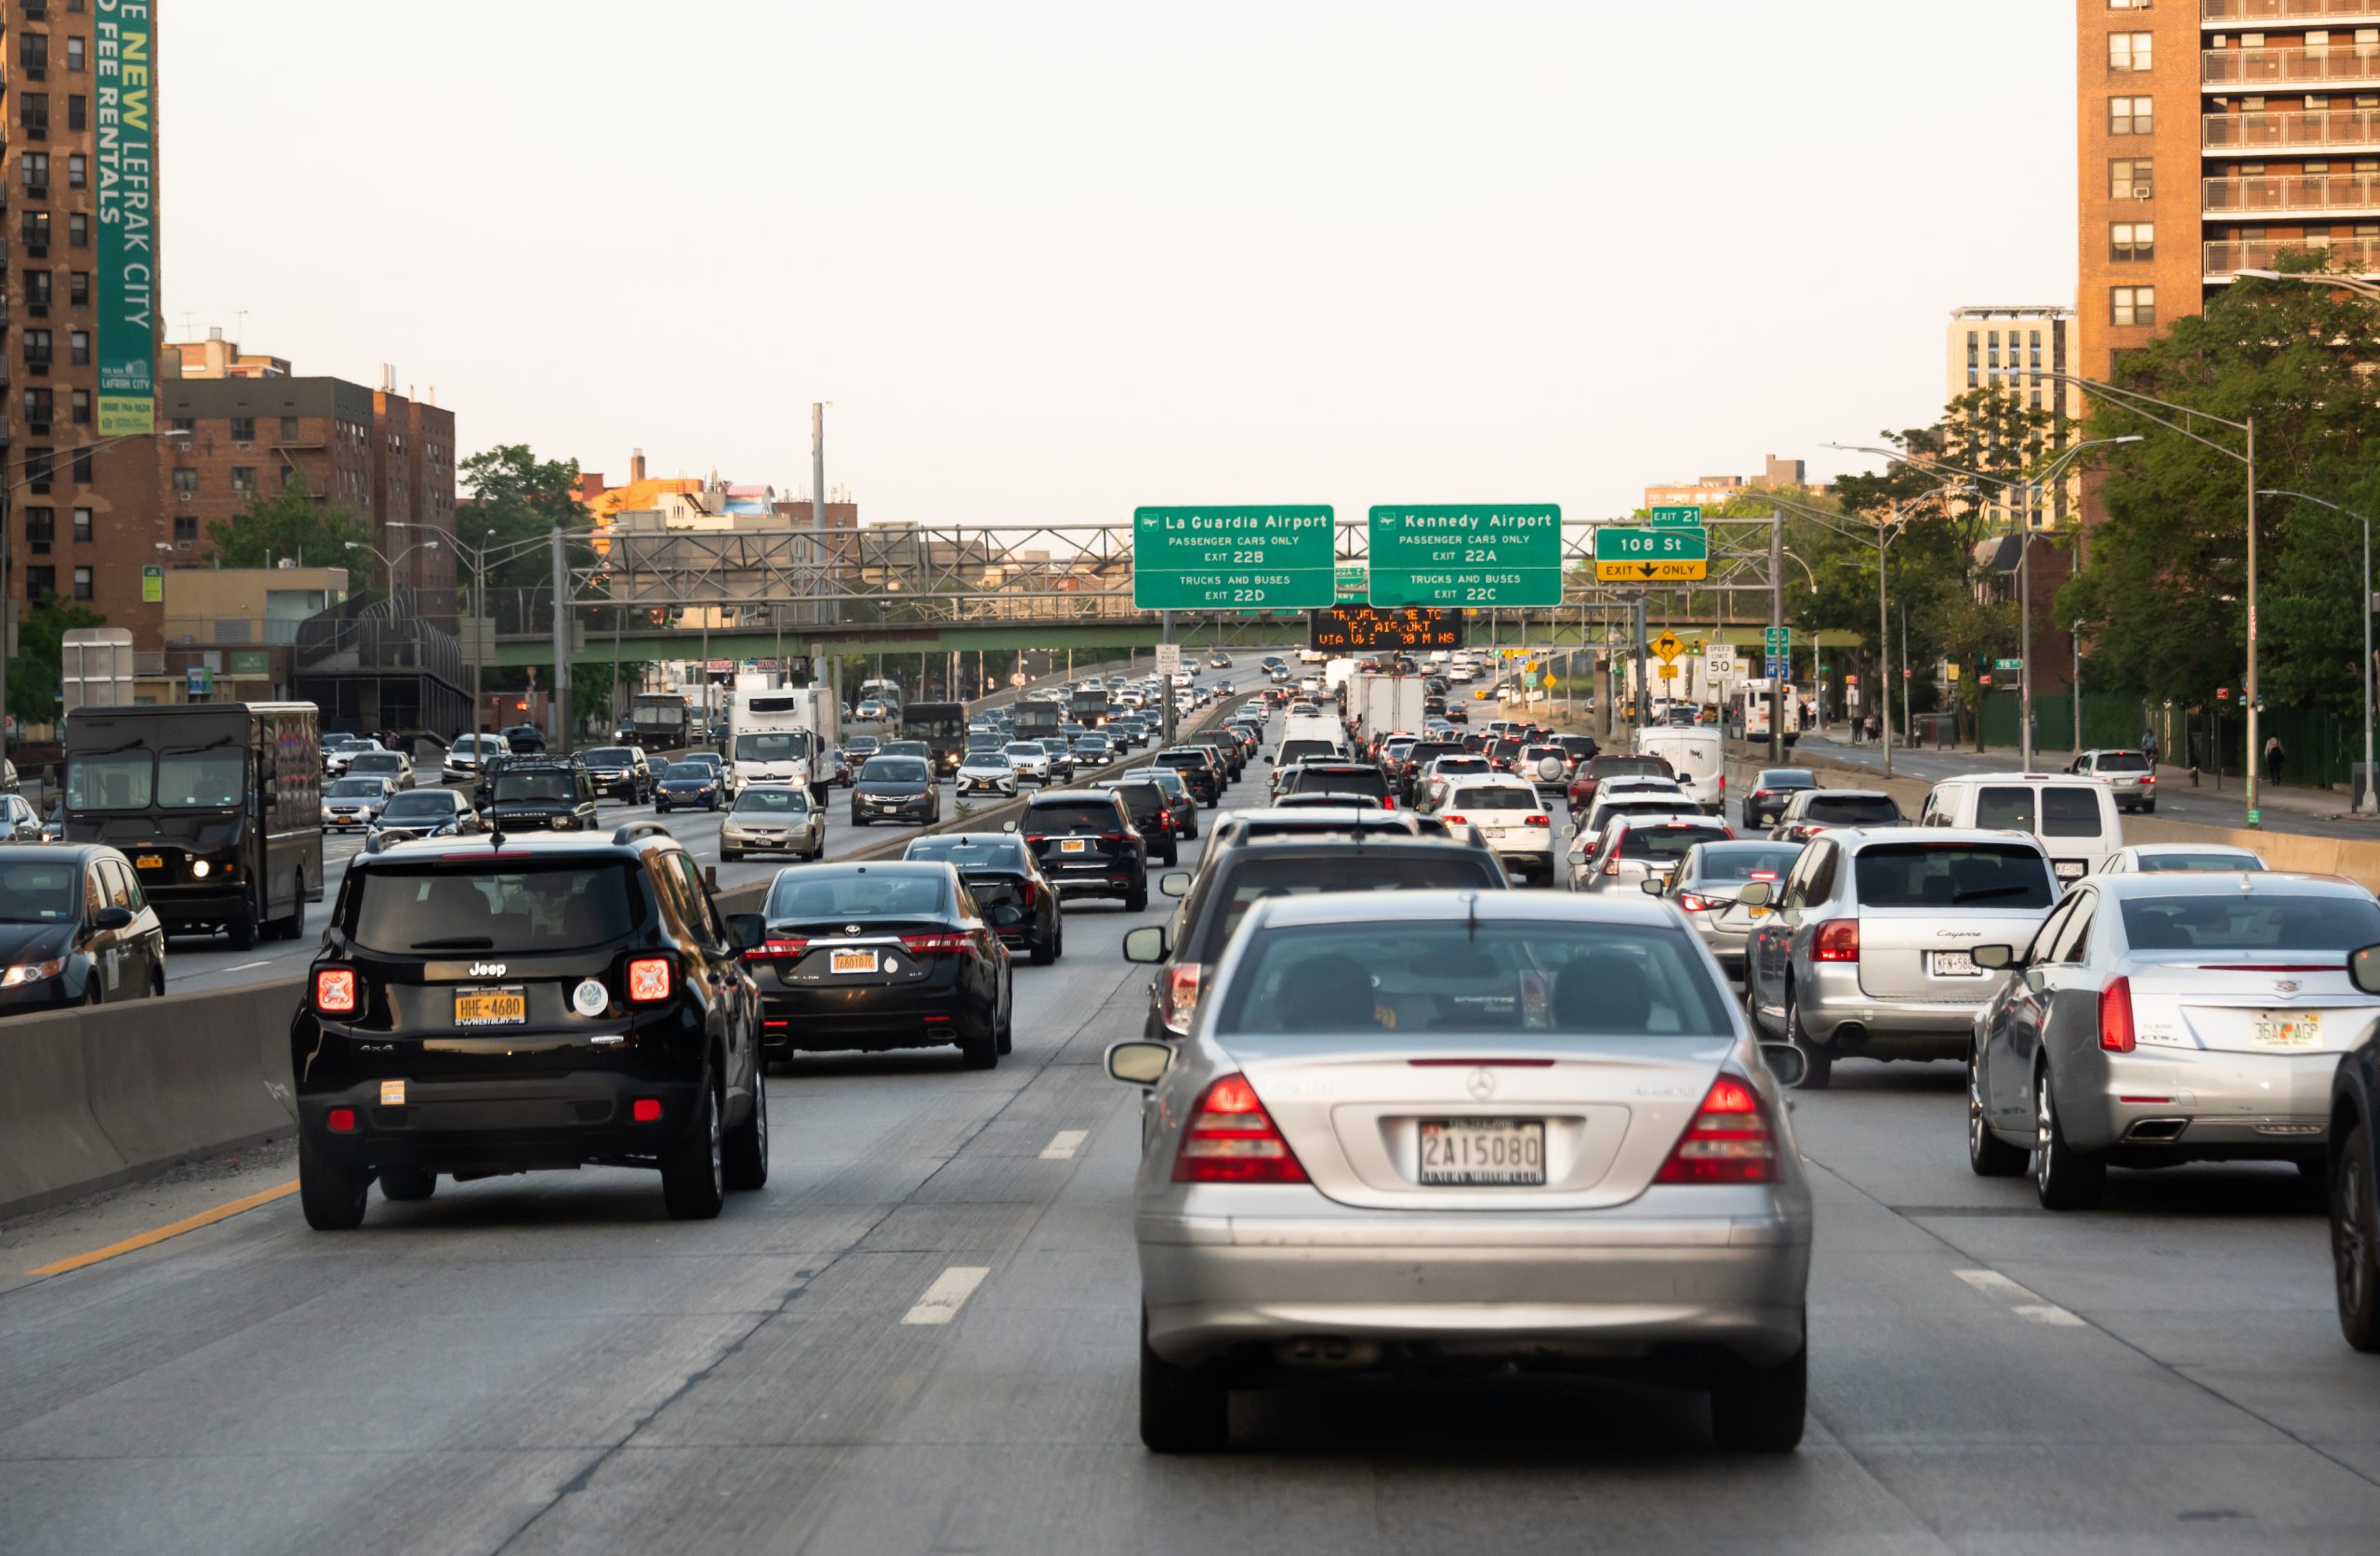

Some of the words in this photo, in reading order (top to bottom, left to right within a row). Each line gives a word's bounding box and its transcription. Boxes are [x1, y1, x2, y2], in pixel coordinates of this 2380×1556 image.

[98, 21, 118, 76] FEE
[122, 32, 148, 131] NEW
[99, 86, 120, 224] RENTALS
[123, 142, 149, 252] LEFRAK
[124, 263, 150, 329] CITY
[1405, 514, 1479, 530] Kennedy
[1489, 513, 1553, 529] Airport
[1654, 512, 1675, 521] EXIT
[1683, 510, 1699, 522] 21
[1165, 516, 1185, 529] La
[1191, 515, 1259, 529] Guardia
[1265, 514, 1328, 531] Airport
[1169, 537, 1232, 546] PASSENGER
[1236, 536, 1265, 546] CARS
[1271, 536, 1300, 545] ONLY
[1399, 535, 1462, 545] PASSENGER
[1467, 535, 1497, 544] CARS
[1501, 534, 1530, 544] ONLY
[1620, 538, 1654, 551] 108
[1663, 538, 1682, 550] St
[1204, 553, 1228, 561] EXIT
[1233, 551, 1264, 563] 22B
[1432, 551, 1456, 560] EXIT
[1464, 549, 1497, 562] 22A
[1606, 566, 1633, 575] EXIT
[1662, 565, 1696, 574] ONLY
[1179, 576, 1222, 585] TRUCKS
[1227, 576, 1250, 585] AND
[1255, 575, 1290, 585] BUSES
[1410, 575, 1452, 584] TRUCKS
[1457, 574, 1479, 584] AND
[1485, 574, 1521, 583] BUSES
[1205, 591, 1228, 600] EXIT
[1234, 589, 1264, 601] 22D
[1435, 590, 1457, 599] EXIT
[1466, 588, 1497, 600] 22C
[1711, 661, 1729, 672] 50
[1937, 929, 1982, 940] Cayenne
[469, 962, 507, 977] Jeep
[1469, 1170, 1510, 1182] MOTOR
[1513, 1170, 1542, 1183] CLUB
